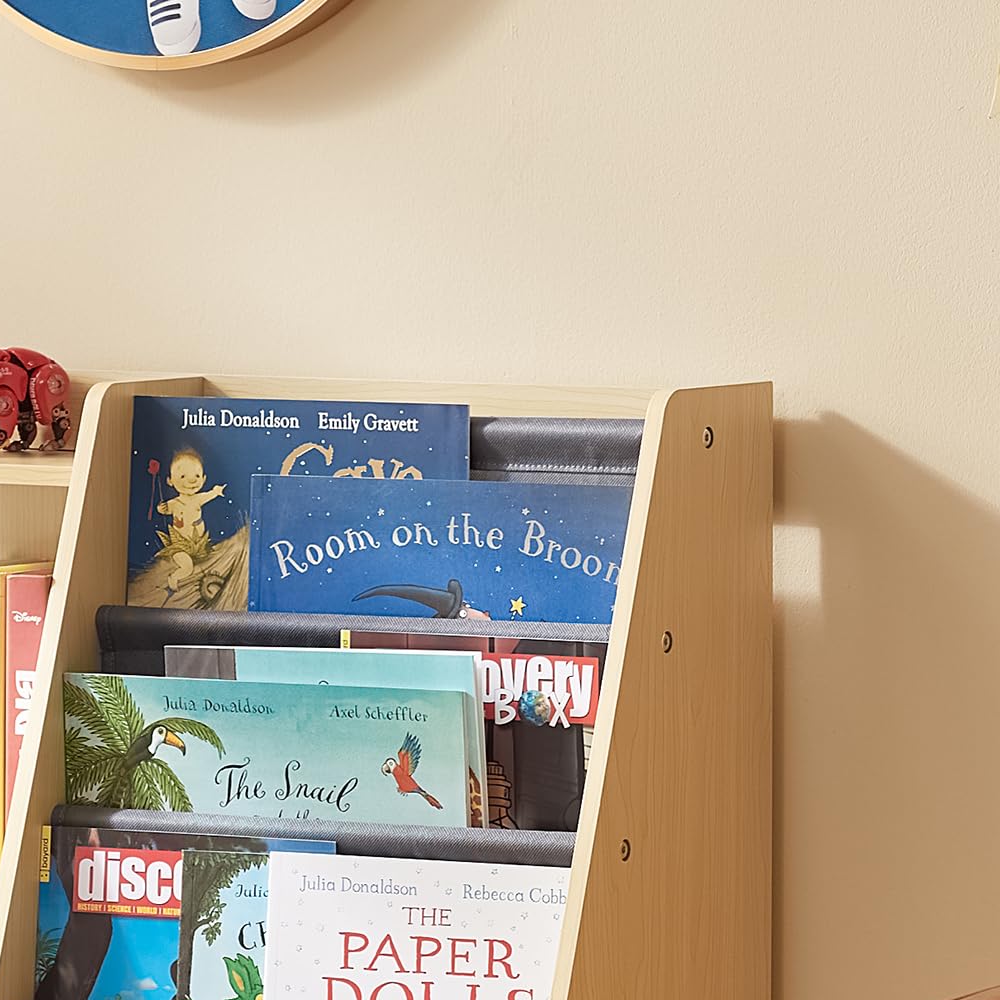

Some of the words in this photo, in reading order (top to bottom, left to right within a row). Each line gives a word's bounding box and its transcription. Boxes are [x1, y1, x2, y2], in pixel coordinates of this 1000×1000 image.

[182, 408, 216, 429] Julia
[220, 409, 300, 429] Donaldson
[318, 411, 361, 433] Emily
[363, 413, 419, 433] Gravett
[269, 526, 380, 579] Room
[392, 523, 438, 547] on
[446, 513, 504, 549] the
[11, 610, 42, 626] Disney
[163, 695, 197, 712] Julia
[202, 698, 274, 715] Donaldson
[329, 705, 359, 719] Axel
[364, 705, 429, 723] Scheffler
[215, 757, 266, 807] The
[275, 759, 359, 812] Snail
[41, 838, 49, 868] bayard
[299, 875, 336, 893] Julia
[341, 877, 418, 896] Donaldson
[462, 883, 524, 903] Rebecca
[529, 887, 567, 904] Cobb
[401, 906, 452, 927] THE
[338, 931, 520, 979] PAPER
